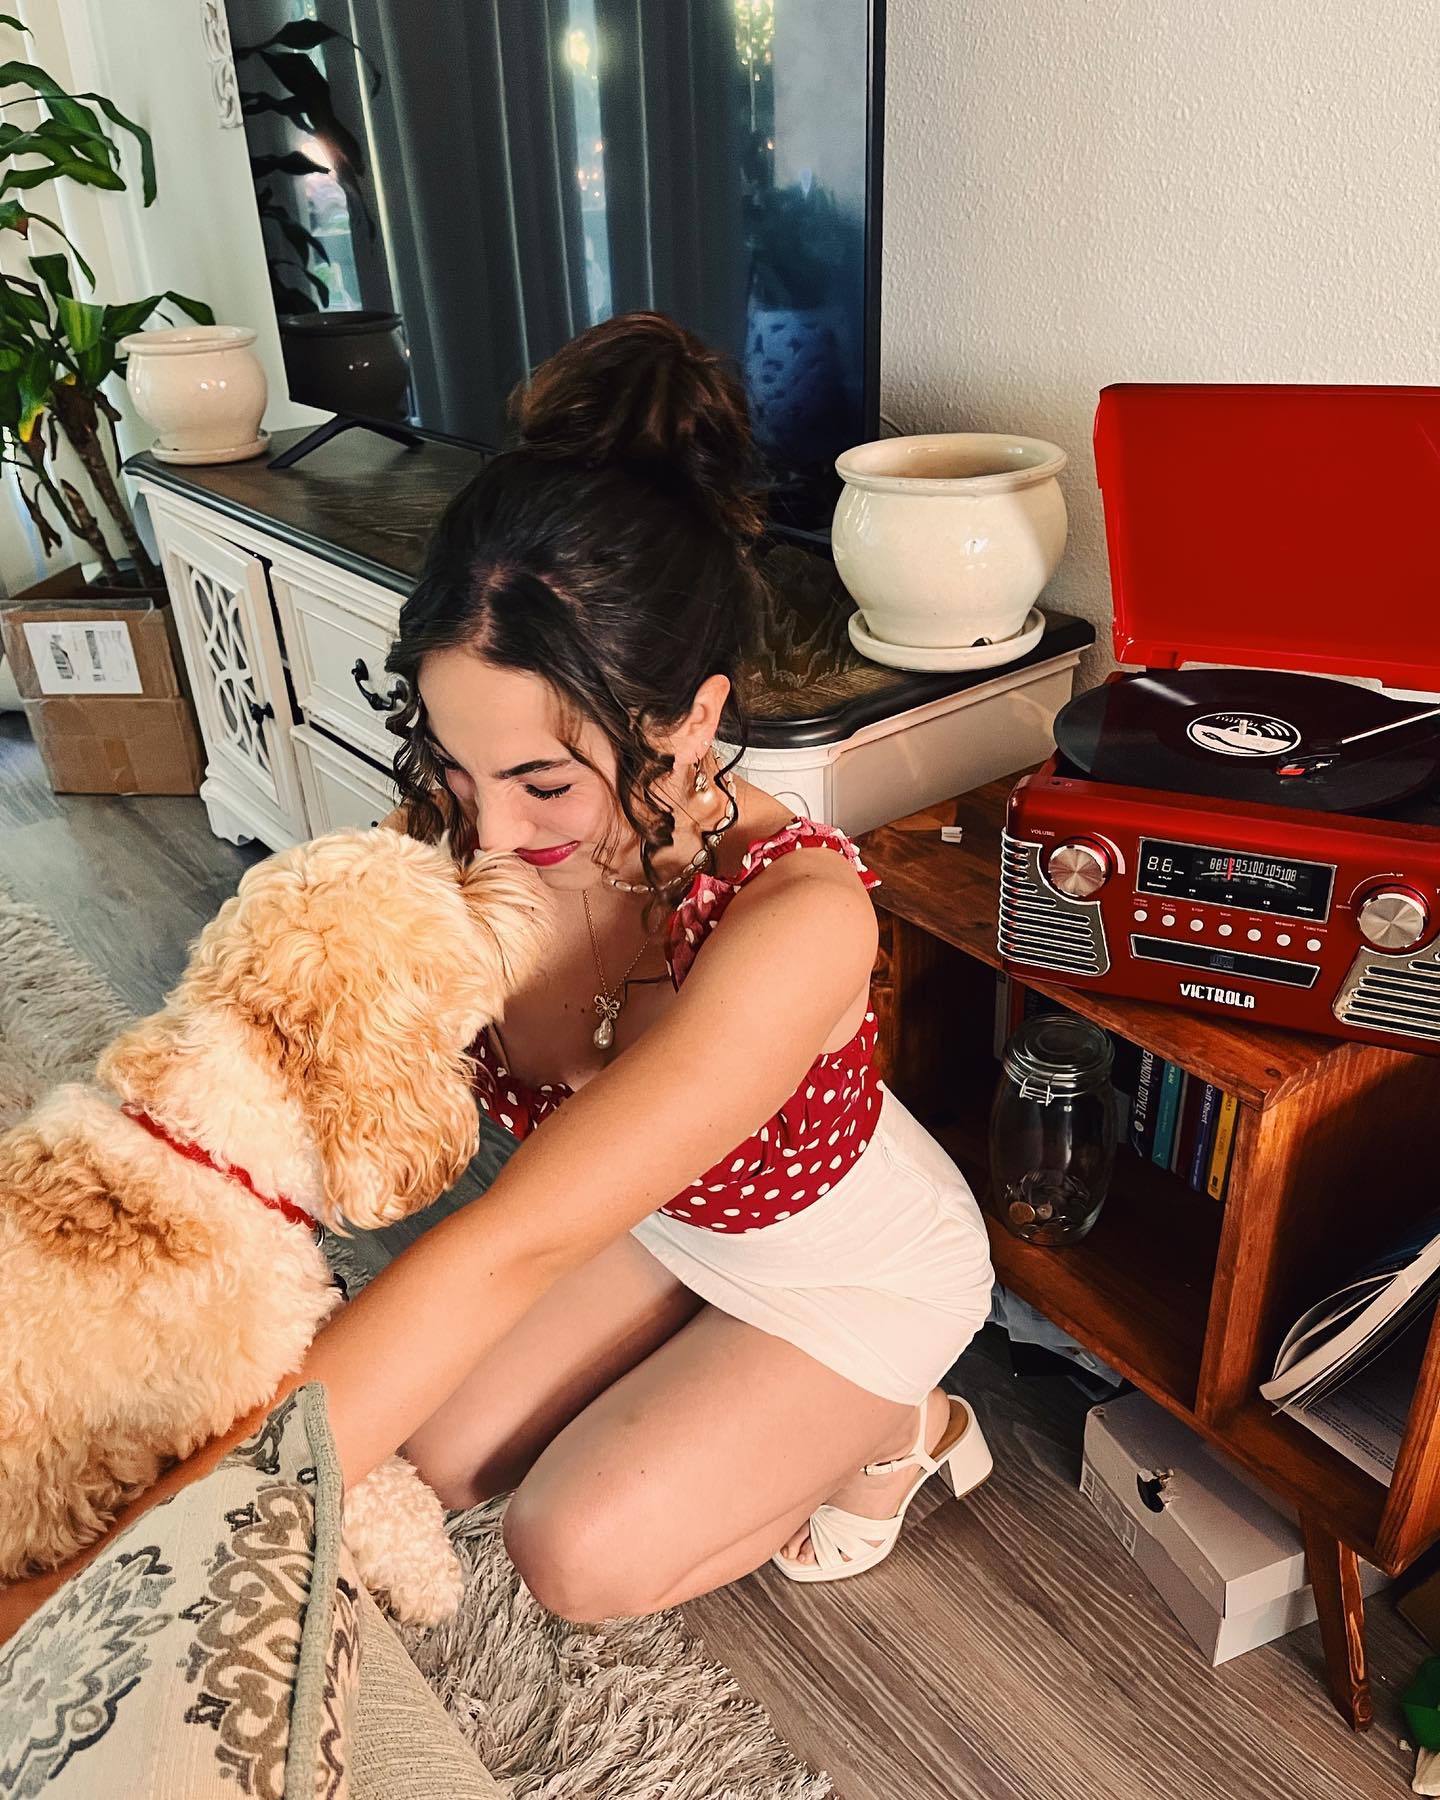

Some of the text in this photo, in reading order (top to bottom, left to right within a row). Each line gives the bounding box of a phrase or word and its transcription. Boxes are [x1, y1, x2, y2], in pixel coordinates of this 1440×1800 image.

[1031, 829, 1055, 837] VOLUME
[1209, 858, 1222, 871] 88
[1235, 858, 1248, 872] 95
[1248, 860, 1265, 875] 100
[1265, 864, 1281, 878] 105
[1281, 869, 1297, 882] 108
[1180, 983, 1255, 1009] VICTROLA
[1135, 1085, 1149, 1119] DOYLE
[1201, 1084, 1214, 1125] Call Sheet
